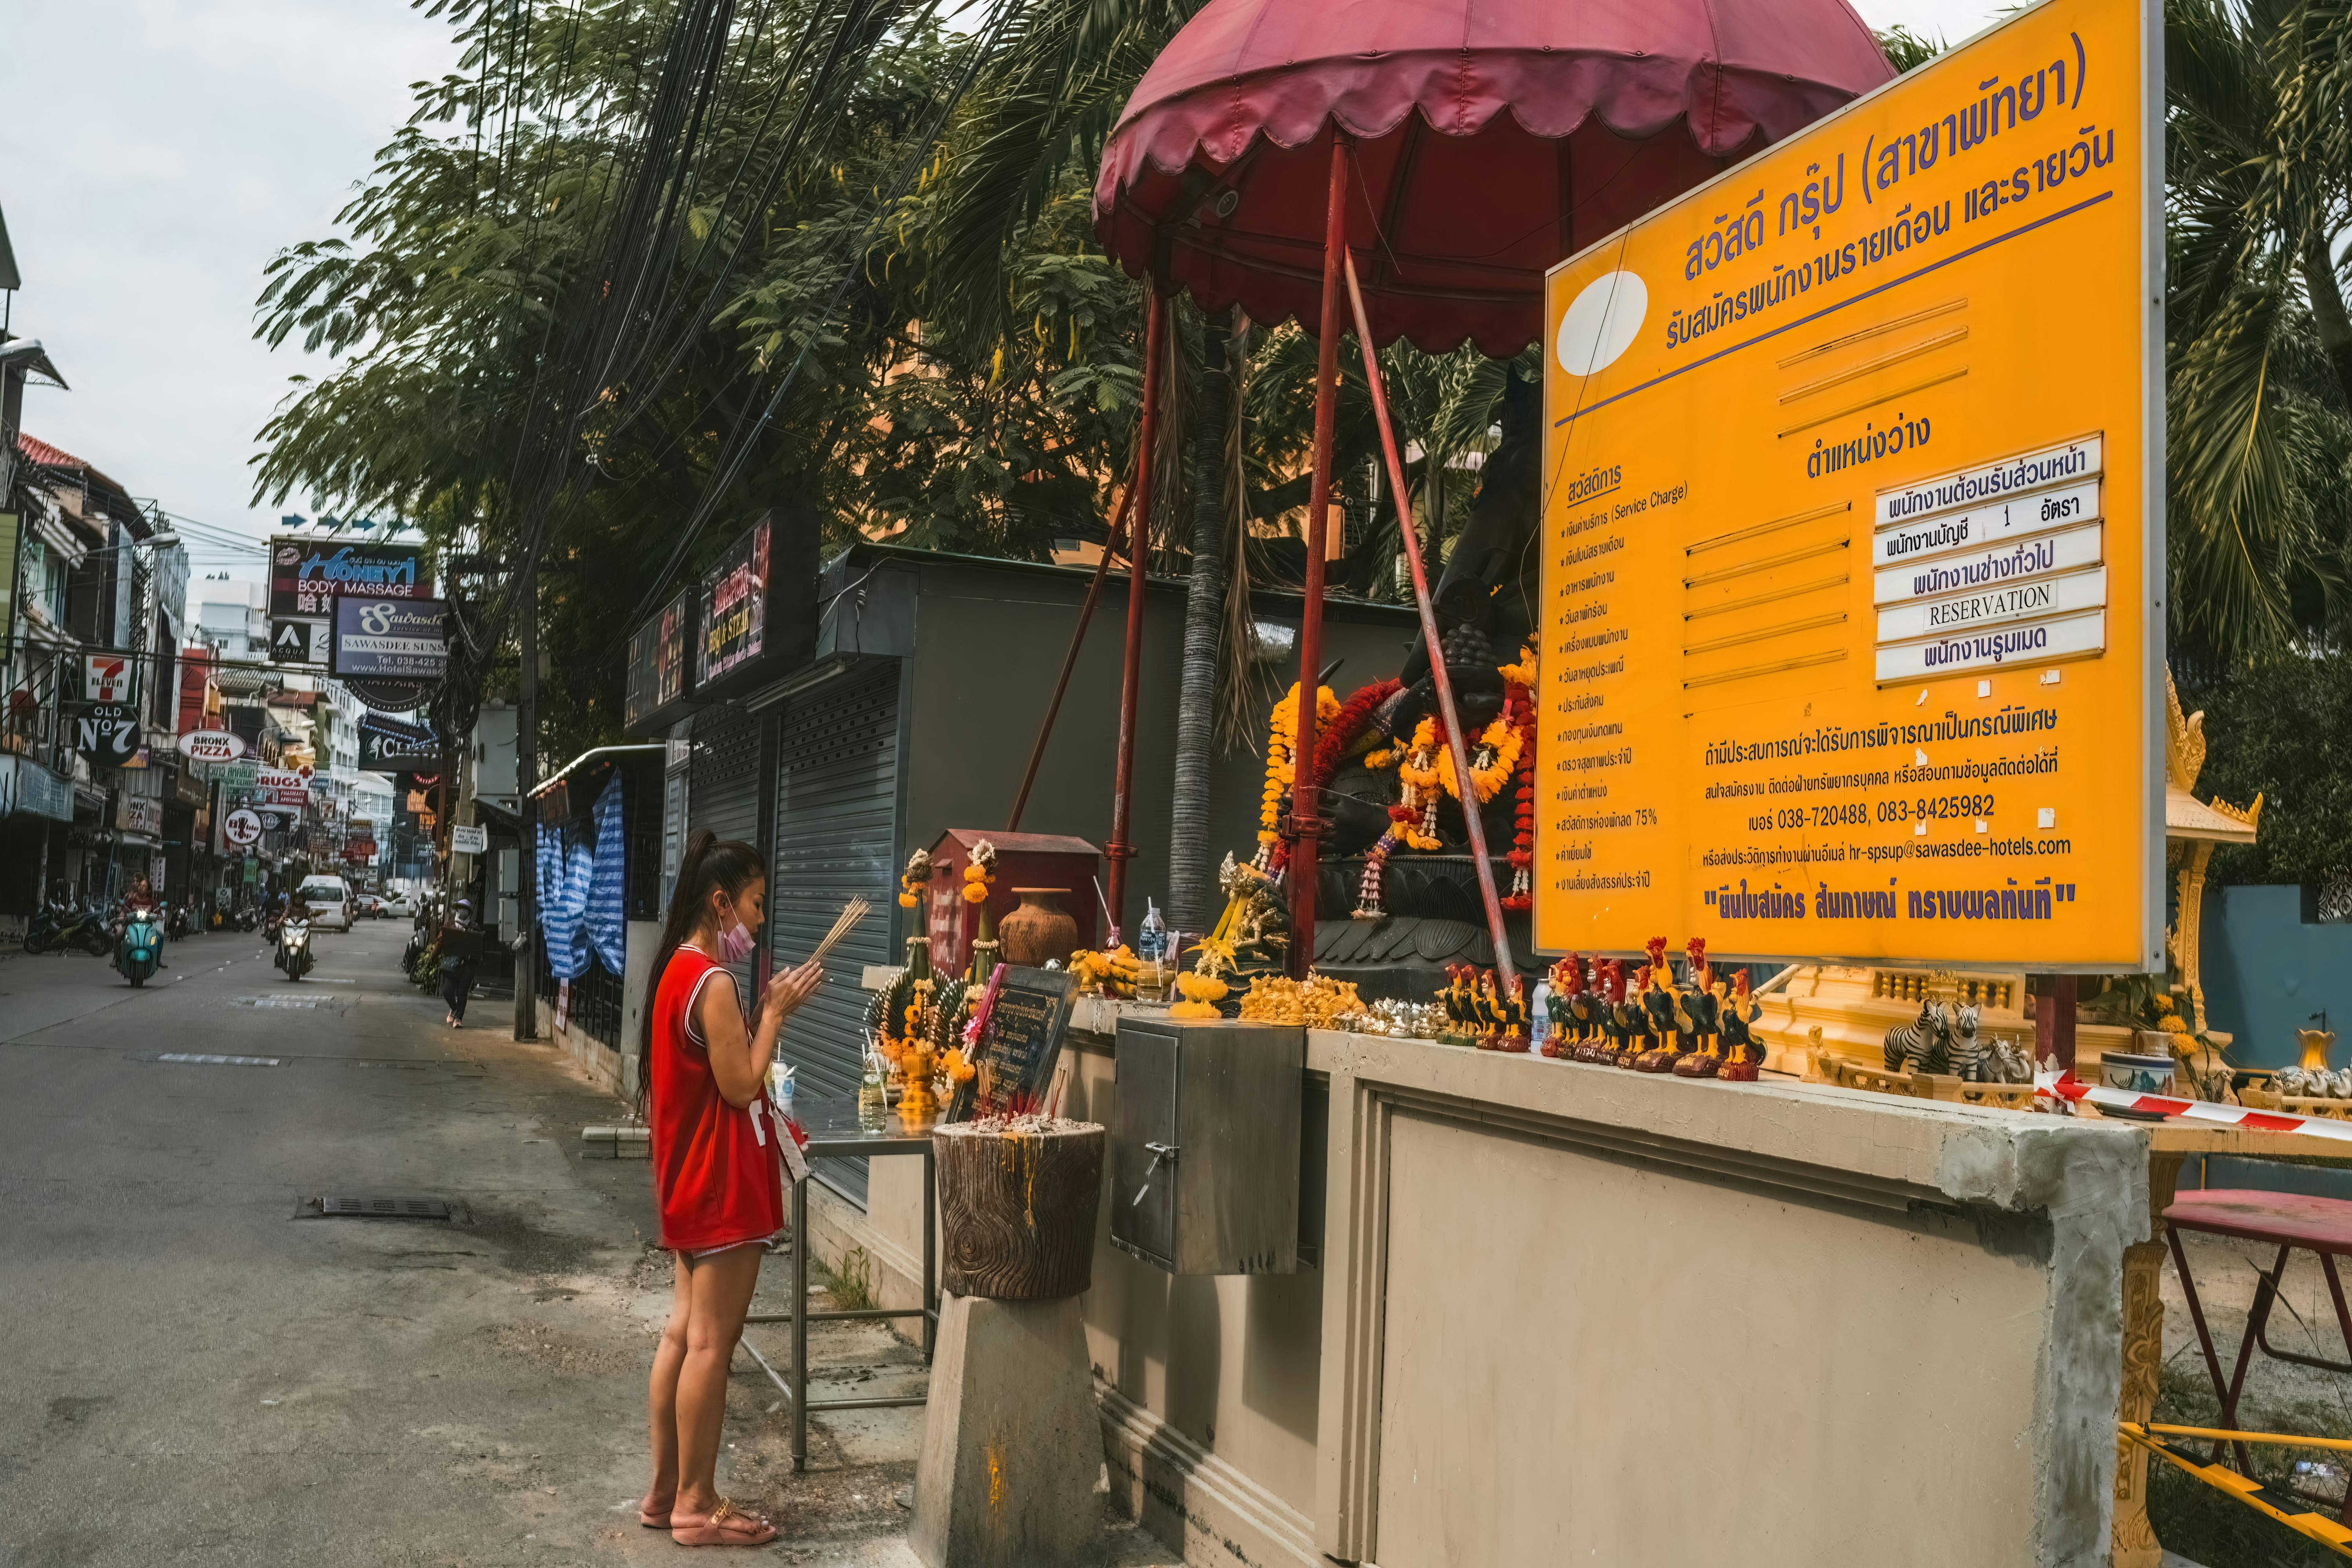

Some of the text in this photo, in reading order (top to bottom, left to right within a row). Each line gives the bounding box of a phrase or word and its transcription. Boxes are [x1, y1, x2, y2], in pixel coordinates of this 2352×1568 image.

[1685, 32, 2085, 281] สวัสดี กรุ๊ป (สาขาพัทยา)
[1666, 125, 2114, 350] รับสมัครพนักงานรายเดือน และรายวัน
[1807, 412, 1931, 479] ตำแหน่งว่าง
[1889, 445, 2085, 518] พนักงานต้อนรับส่วนหน้า
[1612, 498, 1647, 523] (Service
[1650, 480, 1688, 508] Charge)
[1887, 496, 2079, 557] พนักงานบัญชี 1 อัตรา
[1914, 540, 2054, 594] พนักงานช่างทั่วไป
[298, 579, 413, 597] BODY MASSAGE
[1565, 570, 1614, 596] อาหารพนักงาน
[1565, 601, 1608, 625] วันลาพักร้อน
[1929, 584, 2051, 626] RESERVATION
[708, 626, 720, 656] BBQ
[728, 606, 749, 641] STEAK
[1564, 628, 1628, 653] เครื่องแบบพนักงาน
[345, 639, 410, 651] SAWASDEE
[1924, 627, 2046, 667] พนักงานรูมเมด
[93, 657, 124, 702] 7
[1564, 655, 1624, 683] วันลาหยุดประเพณี
[94, 706, 122, 717] OLD
[1563, 693, 1604, 713] ประกันสังคม
[194, 736, 230, 746] BRONX
[1562, 722, 1622, 744] กองทุนเงินทดแทน
[1706, 705, 2058, 766] ถ้ามีประสบการณ์จะได้รับการพิจารณาเป็นกรณีพิเศษ
[191, 745, 232, 757] PIZZA
[1562, 747, 1632, 773] ตรวจสุขภาพประจำปี
[1706, 746, 2058, 799] สนใจสมัครงาน ติดต่อฝ่ายทรัพยากรบุคคล หรือสอบถามข้อมูลติดต่อได้ที่
[1561, 779, 1607, 801] เงินค่าตำแหน่ง
[1635, 808, 1657, 826] 75%
[1749, 794, 1994, 831] เบอร์ 038-720488, 083-8425982
[1561, 840, 1592, 861] ค่าเยี่ยมไข้
[1849, 837, 2071, 863] hr-spsup@sawasdee-hotels.com
[1561, 869, 1650, 890] งานเลี้ยงสังสรรค์ประจำปี
[1815, 877, 1897, 918] สัมภาษณ์
[1908, 877, 2075, 919] ทราบผลทันที"
